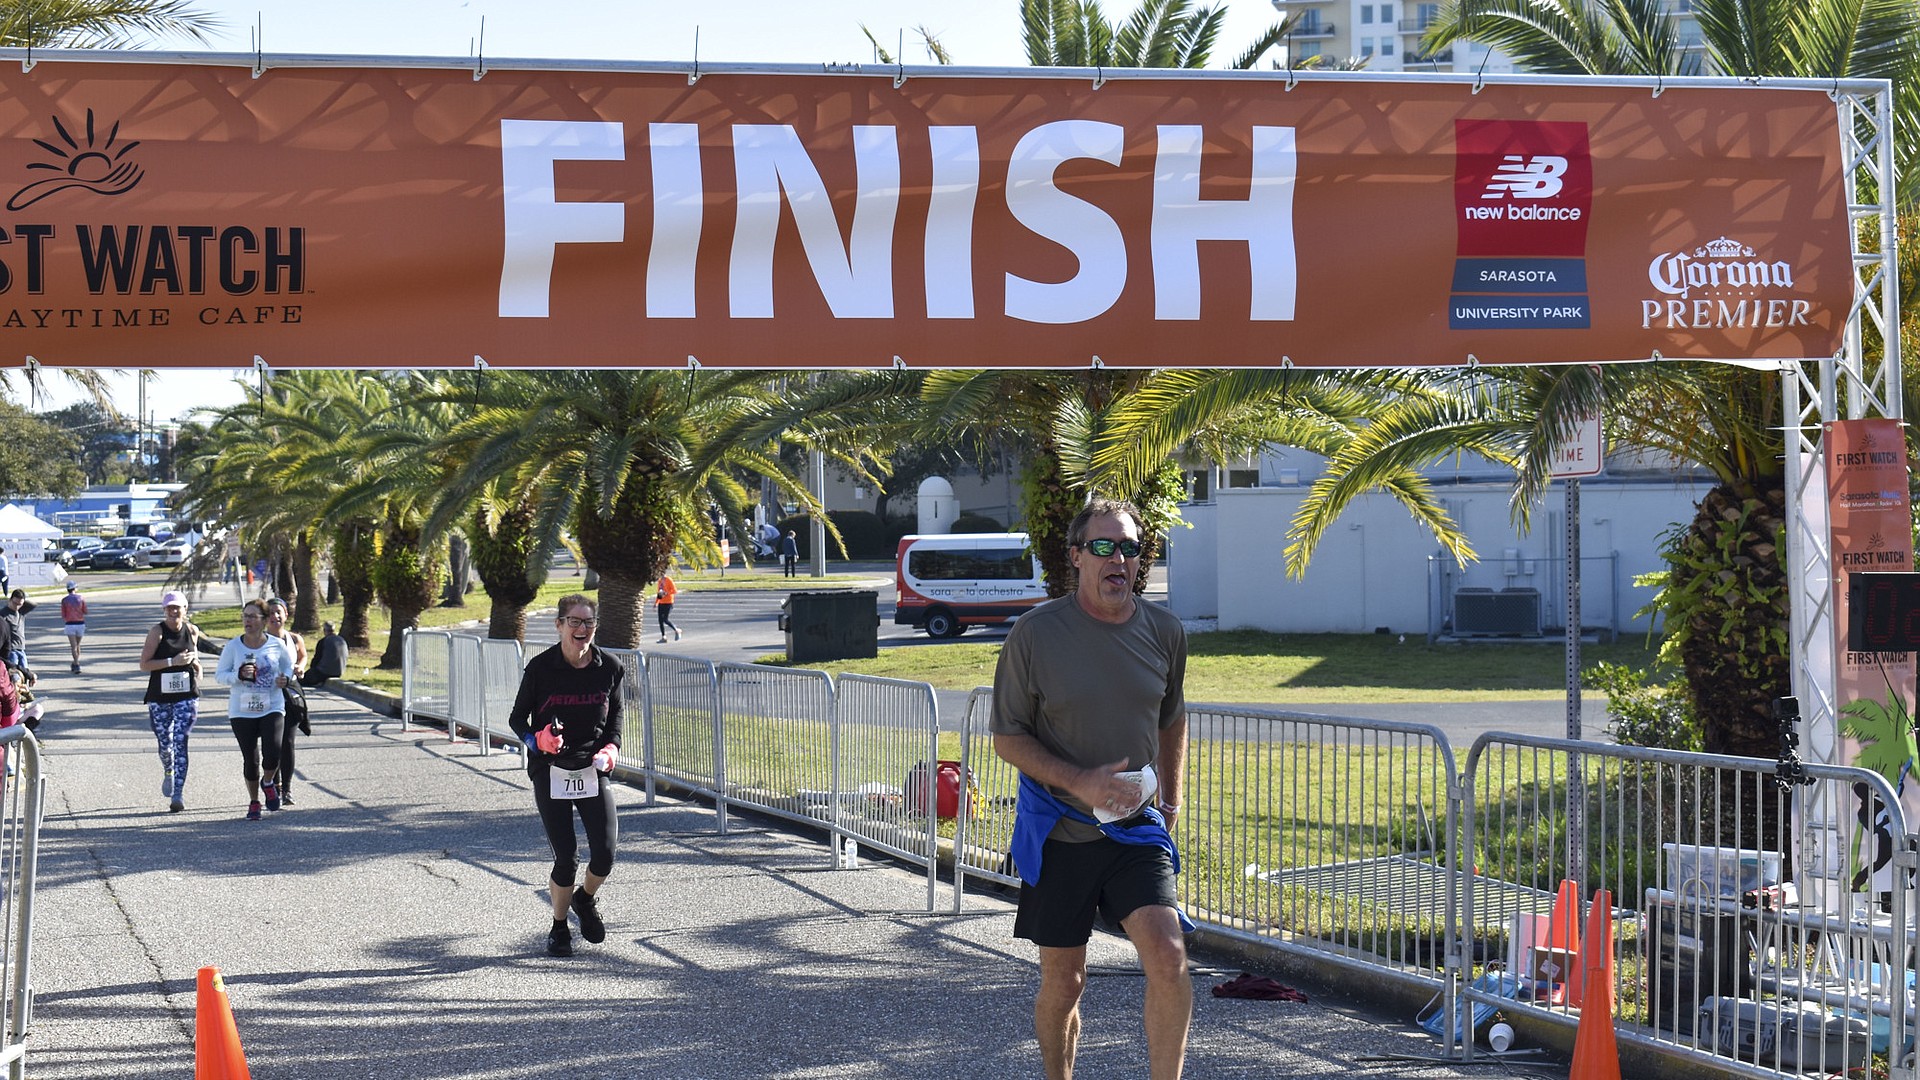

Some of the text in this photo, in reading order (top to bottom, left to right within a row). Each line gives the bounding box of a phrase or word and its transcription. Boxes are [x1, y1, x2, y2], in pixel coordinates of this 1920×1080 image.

[1465, 204, 1582, 221] new balance
[498, 119, 1297, 324] FINISH
[75, 224, 305, 296] WATCH
[1479, 270, 1557, 282] SARASOTA
[1648, 251, 1794, 300] Corona
[199, 305, 302, 325] CAFE
[1456, 306, 1583, 319] UNIVERSITY PARK
[1641, 299, 1811, 329] PREMIER
[1837, 452, 1897, 465] FIRST WATCH
[1840, 491, 1879, 501] Sarasota
[1843, 552, 1904, 565] FIRST WATCH
[930, 585, 1023, 597] sarata orchestra
[1847, 651, 1908, 665] FIRST WATCH
[564, 779, 584, 791] 710
